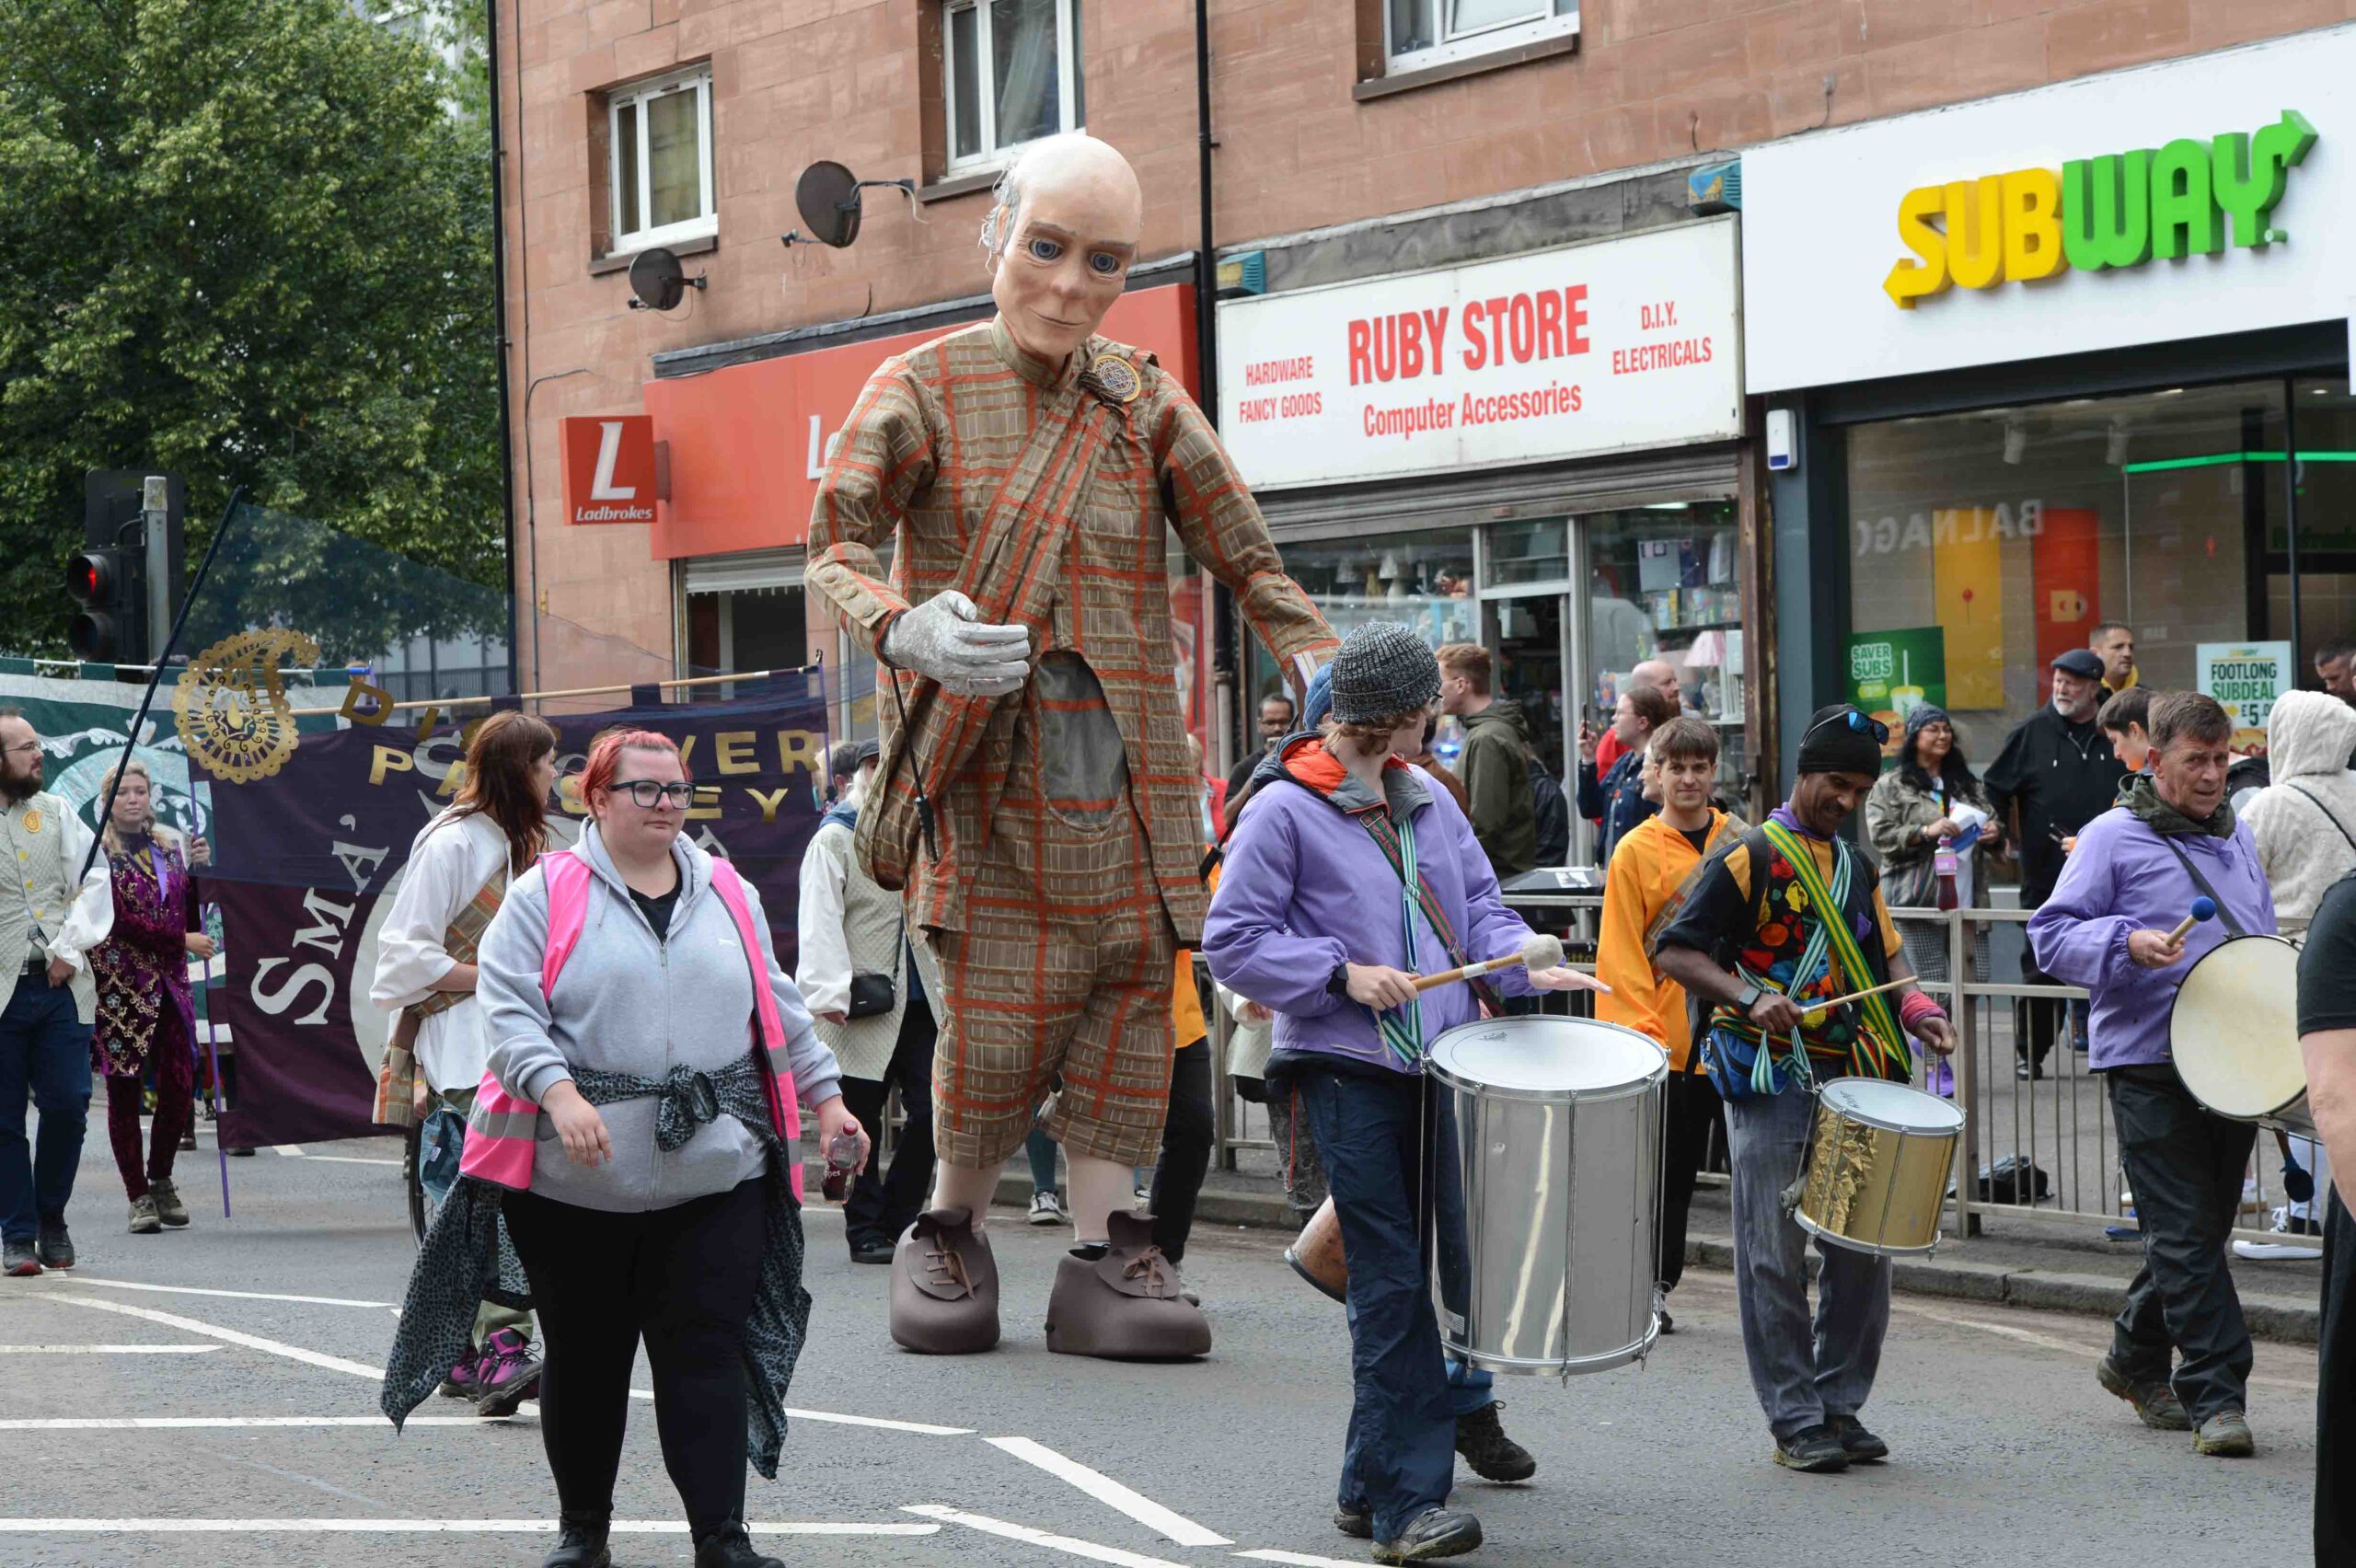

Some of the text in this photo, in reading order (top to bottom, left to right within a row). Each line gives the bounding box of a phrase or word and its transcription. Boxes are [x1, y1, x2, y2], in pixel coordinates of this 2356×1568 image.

[1883, 110, 2318, 309] SUBWAY
[1640, 301, 1679, 330] D.I.Y.
[1348, 283, 1590, 386] RUBY STORE
[1245, 355, 1313, 386] HARDWARE
[1611, 336, 1713, 375] ELECTRICALS
[1239, 391, 1322, 423] FANCY GOODS
[1363, 380, 1583, 441] Computer Accessories
[590, 421, 637, 501] L
[575, 504, 653, 522] Ladbrokes
[1852, 644, 1891, 660] SAVER
[1853, 660, 1892, 678] SUBS
[2211, 662, 2278, 681] FOOTLONG
[2212, 681, 2278, 700] SUBDEAL
